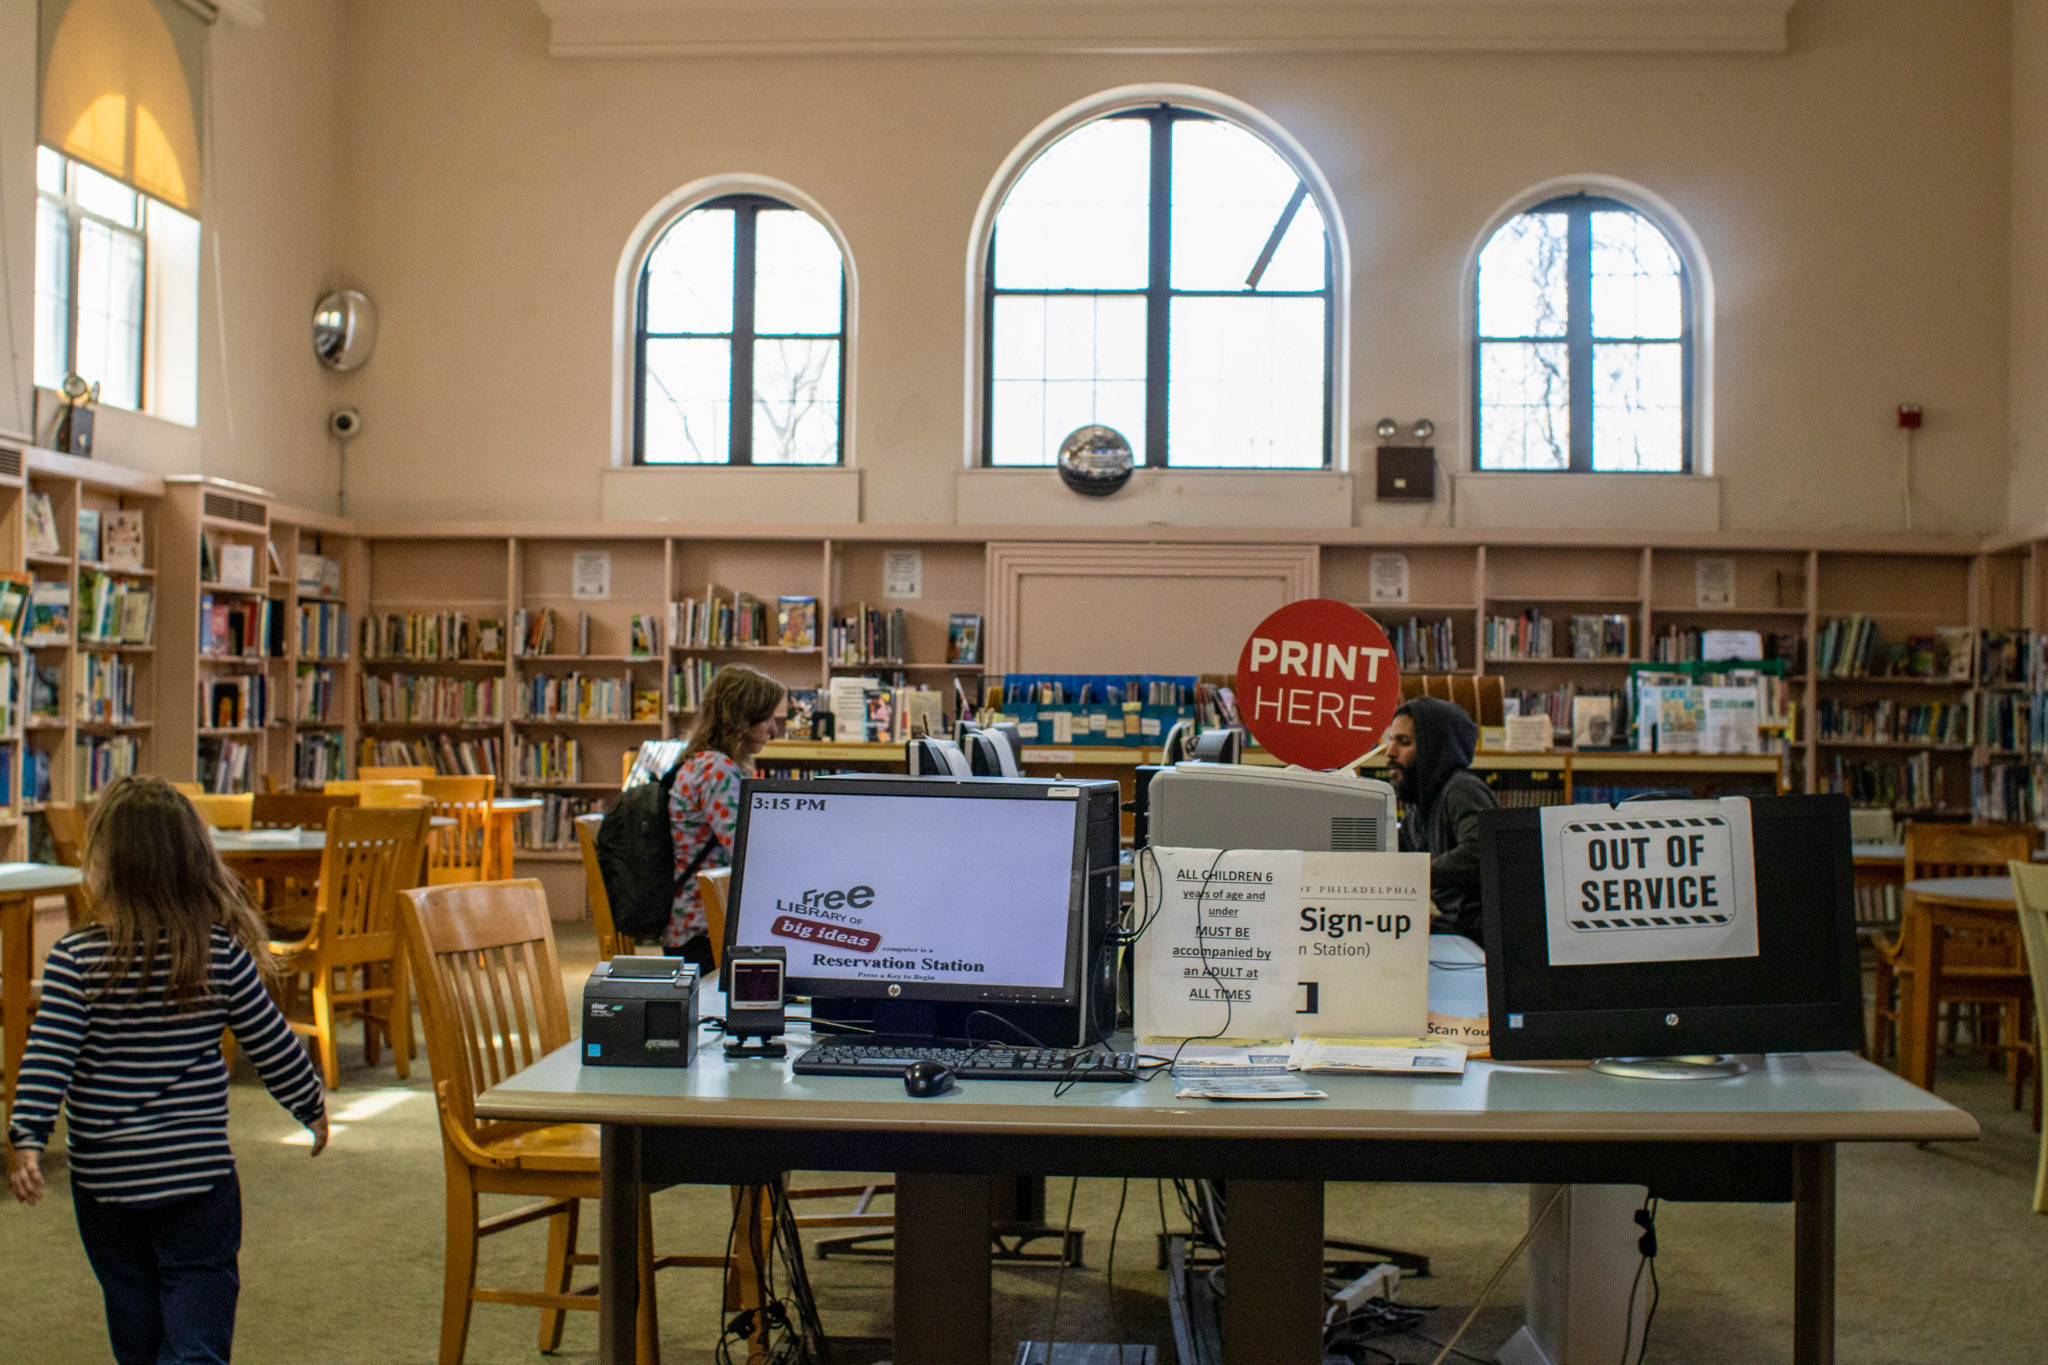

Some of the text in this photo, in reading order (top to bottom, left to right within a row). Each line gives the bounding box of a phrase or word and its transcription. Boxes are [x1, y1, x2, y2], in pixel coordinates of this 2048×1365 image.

[1250, 637, 1389, 683] PRINT
[1254, 686, 1375, 731] HERE
[753, 797, 826, 811] 3:15 PM
[1587, 834, 1705, 871] OUT OF
[1177, 869, 1273, 882] ALL CHILDREN 6
[802, 885, 875, 910] Free
[1183, 890, 1265, 900] years of age and
[1320, 886, 1417, 895] PHILADELPHIA
[1581, 875, 1719, 913] SERVICE
[776, 899, 863, 925] LIBRARY OF
[1208, 907, 1239, 916] under
[1300, 906, 1411, 940] Sign-up
[782, 920, 869, 947] big ideas
[1195, 926, 1250, 937] MUST BE
[882, 946, 918, 954] computer
[1172, 947, 1271, 960] accompanied by
[1313, 942, 1370, 958] Station)
[812, 953, 985, 973] Reservation Station
[887, 973, 901, 981] Key
[1184, 967, 1258, 978] an ADULT at
[888, 984, 901, 997] hp
[1189, 988, 1251, 1000] ALL TIMES
[1427, 1022, 1459, 1036] Scan
